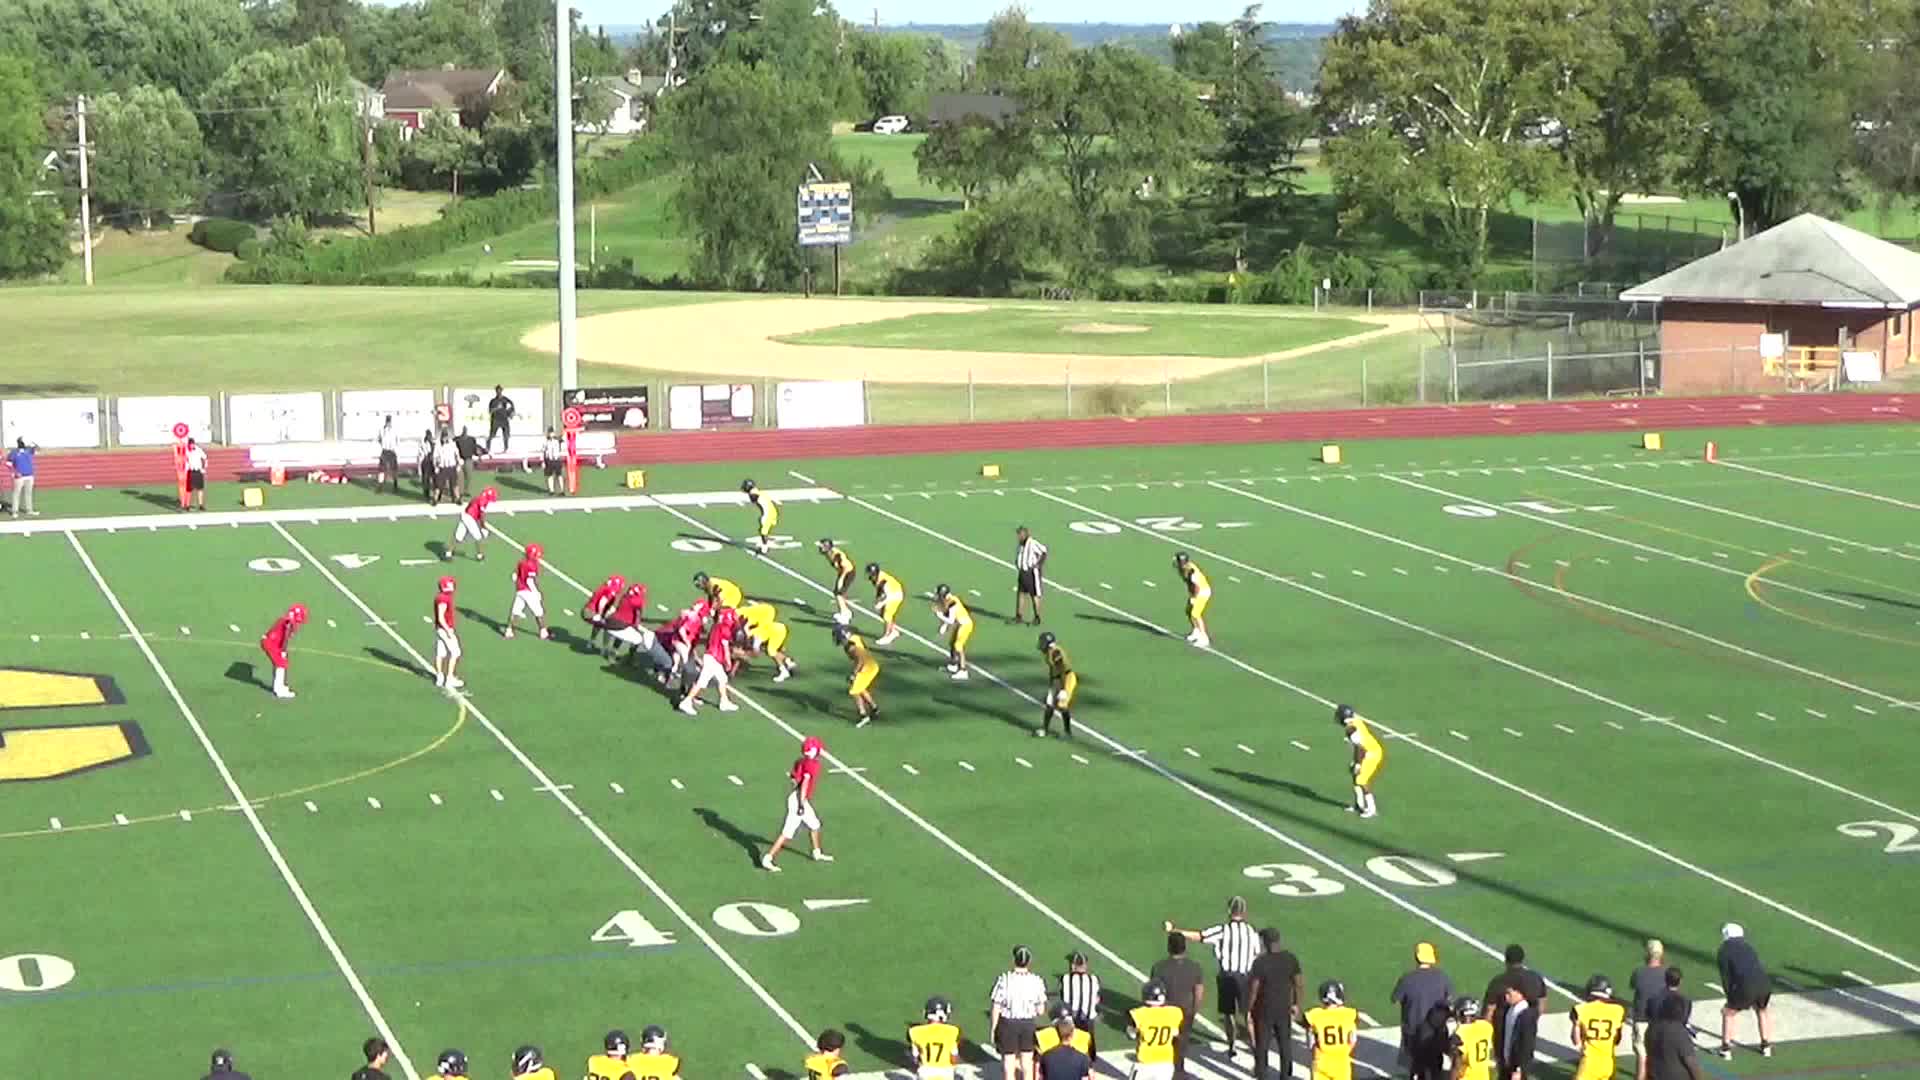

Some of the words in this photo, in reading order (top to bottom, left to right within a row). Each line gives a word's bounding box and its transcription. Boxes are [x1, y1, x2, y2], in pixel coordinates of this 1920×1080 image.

[1147, 1026, 1172, 1047] 70
[1324, 1025, 1345, 1045] 61
[1586, 1019, 1613, 1040] 53
[925, 1043, 944, 1063] 17
